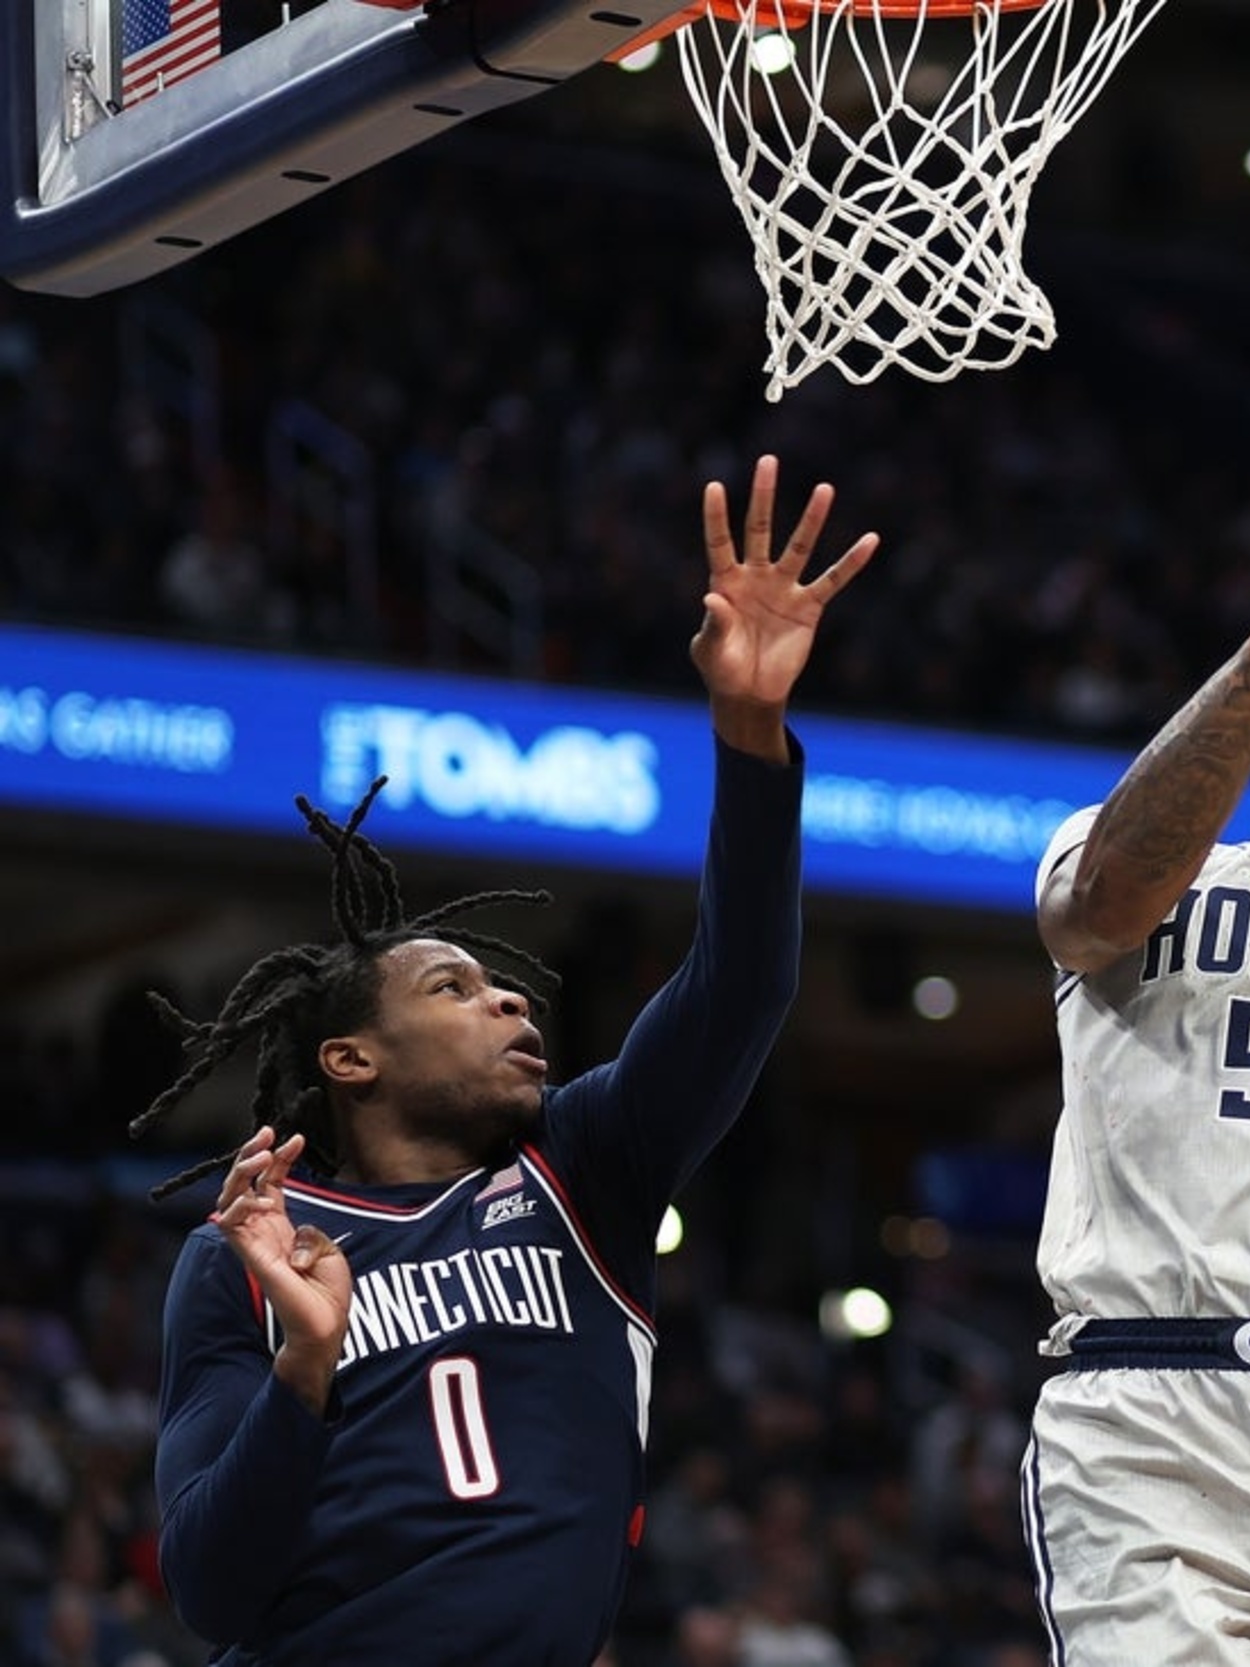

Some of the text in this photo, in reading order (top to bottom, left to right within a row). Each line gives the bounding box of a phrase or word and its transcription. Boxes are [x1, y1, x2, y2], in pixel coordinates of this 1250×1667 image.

[368, 704, 661, 835] TOMBS
[336, 1245, 574, 1371] NNECTICUT
[429, 1355, 499, 1500] 0
